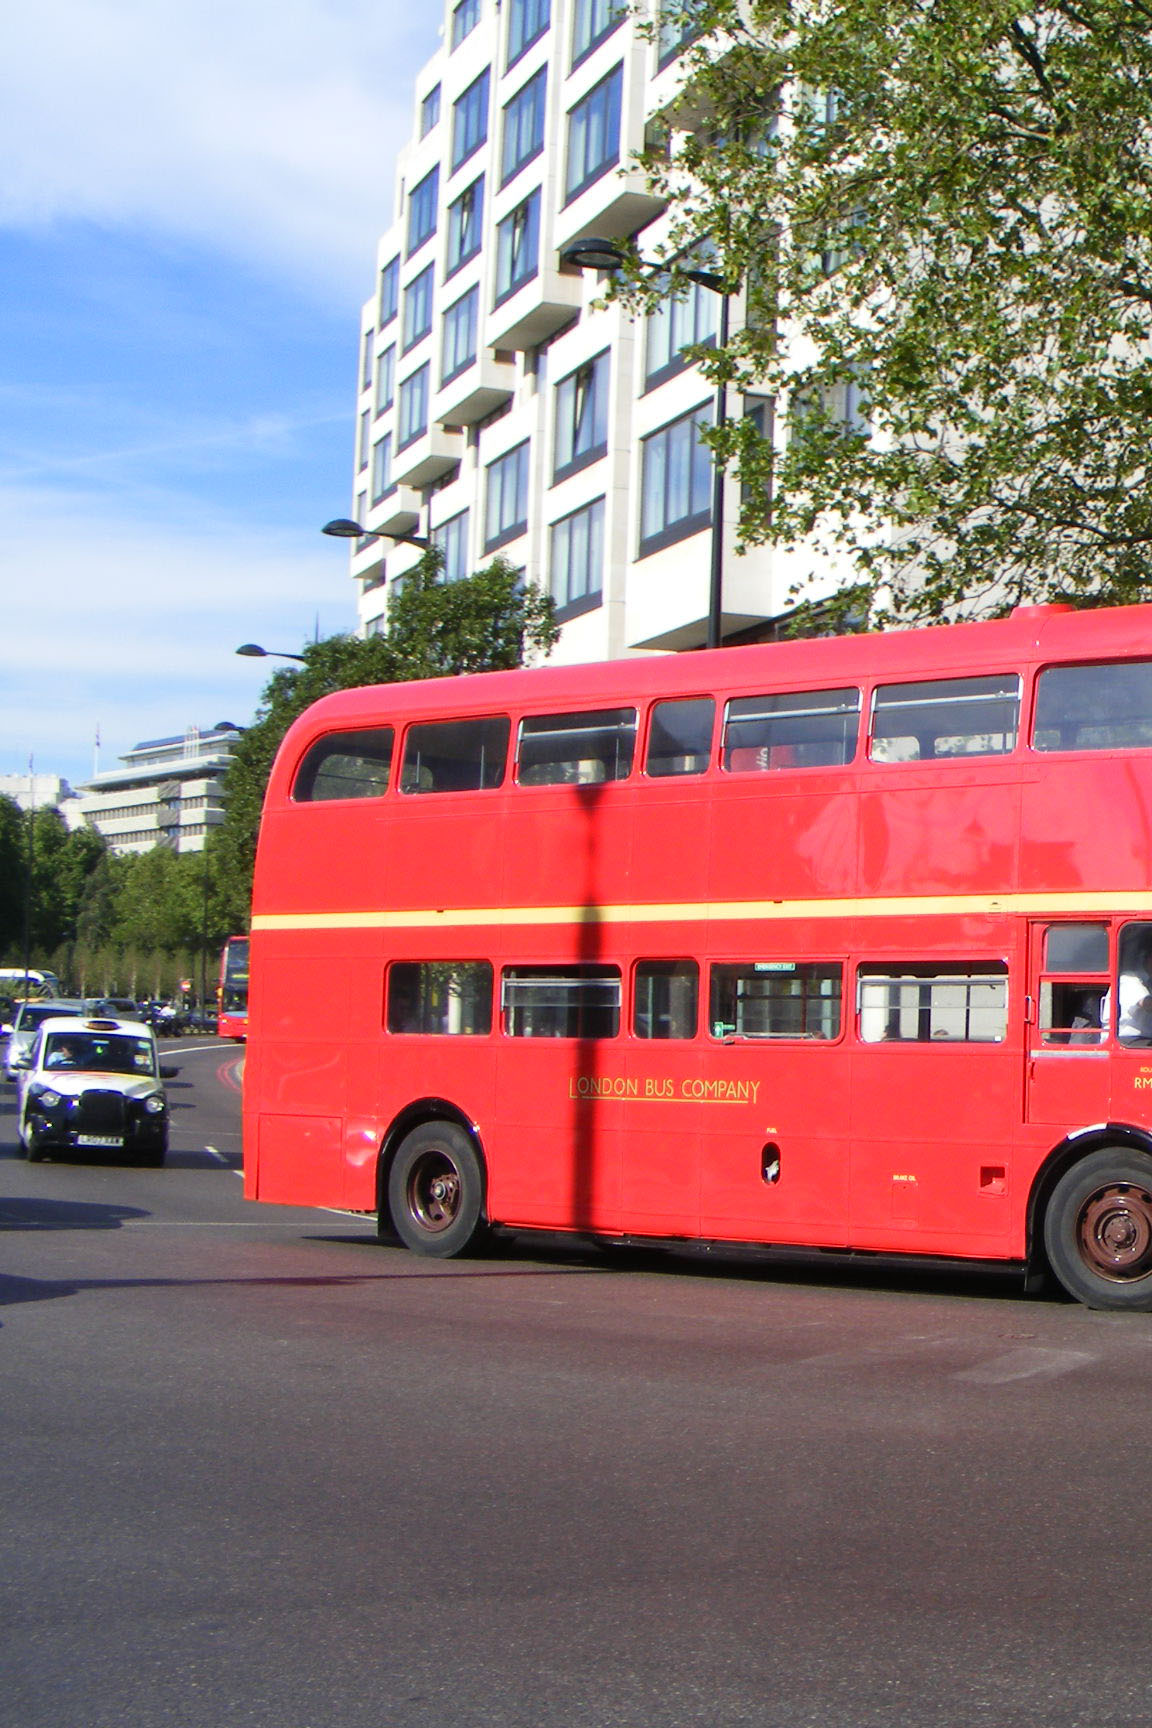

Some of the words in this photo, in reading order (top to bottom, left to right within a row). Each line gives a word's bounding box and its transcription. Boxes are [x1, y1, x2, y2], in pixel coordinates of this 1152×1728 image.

[569, 1077, 638, 1098] LONDON
[645, 1079, 674, 1096] BUS
[681, 1079, 760, 1103] COMPANY
